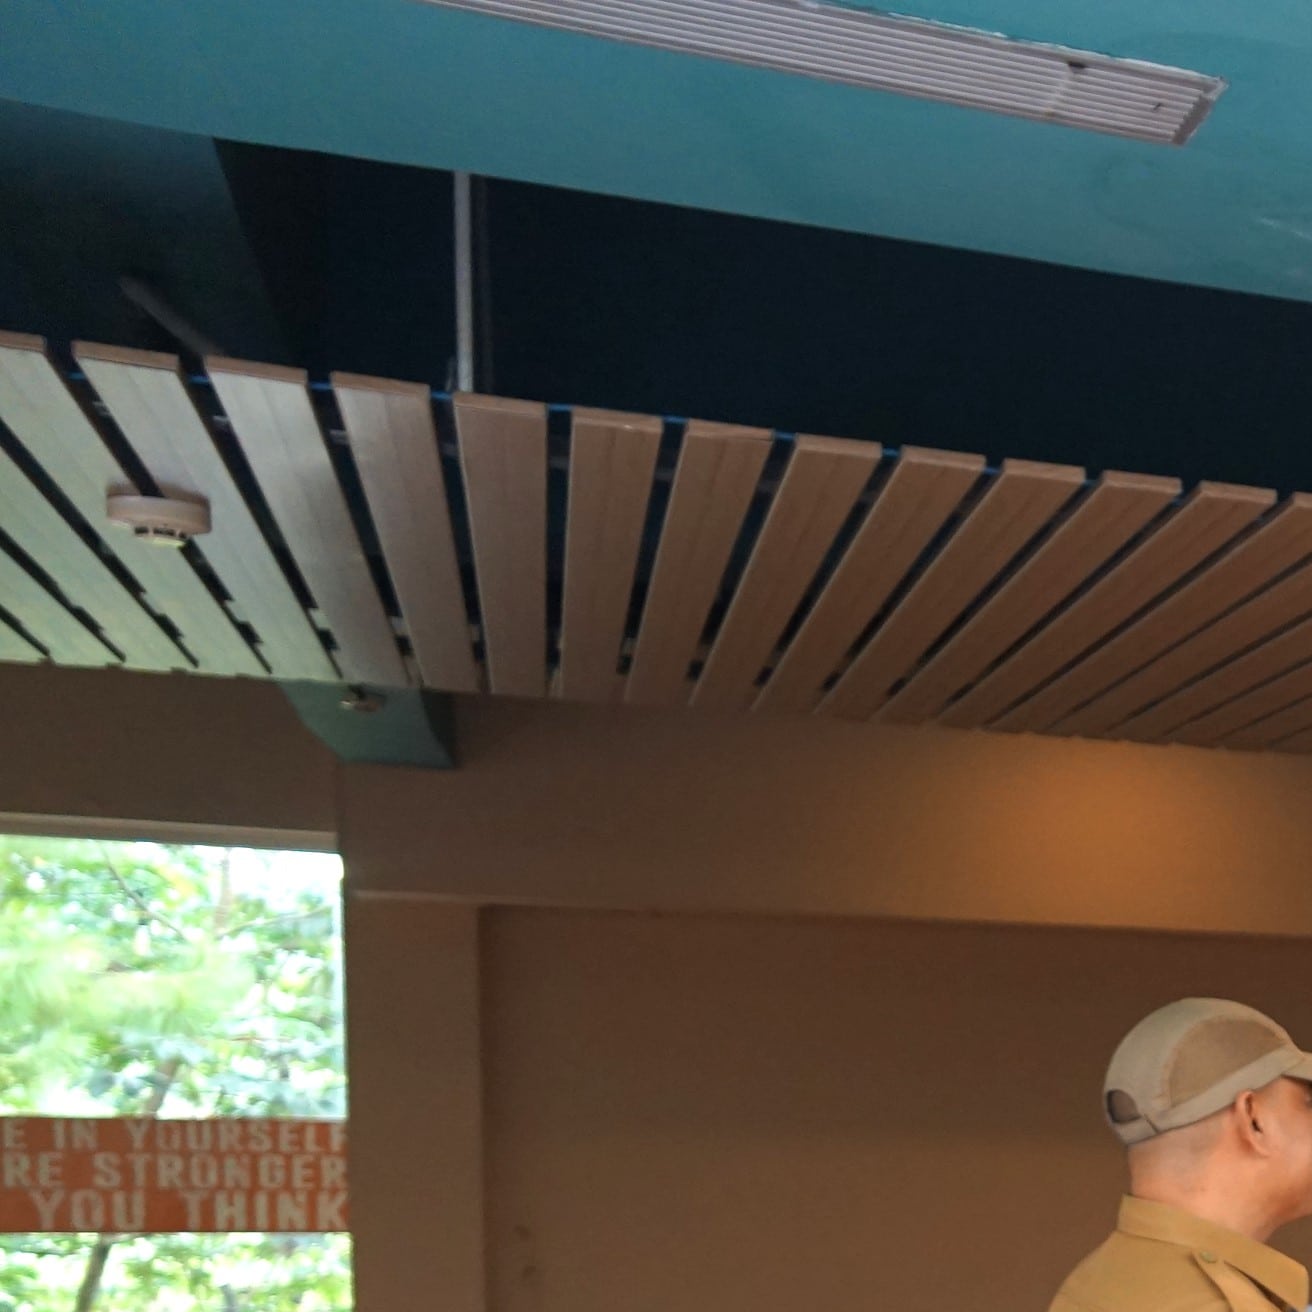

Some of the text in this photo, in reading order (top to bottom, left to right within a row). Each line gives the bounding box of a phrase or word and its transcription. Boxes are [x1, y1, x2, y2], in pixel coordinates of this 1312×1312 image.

[53, 1117, 99, 1149] IN
[124, 1119, 347, 1153] YOURSELF
[3, 1151, 348, 1190] RE STRONGER
[29, 1188, 349, 1231] YOU THINK
